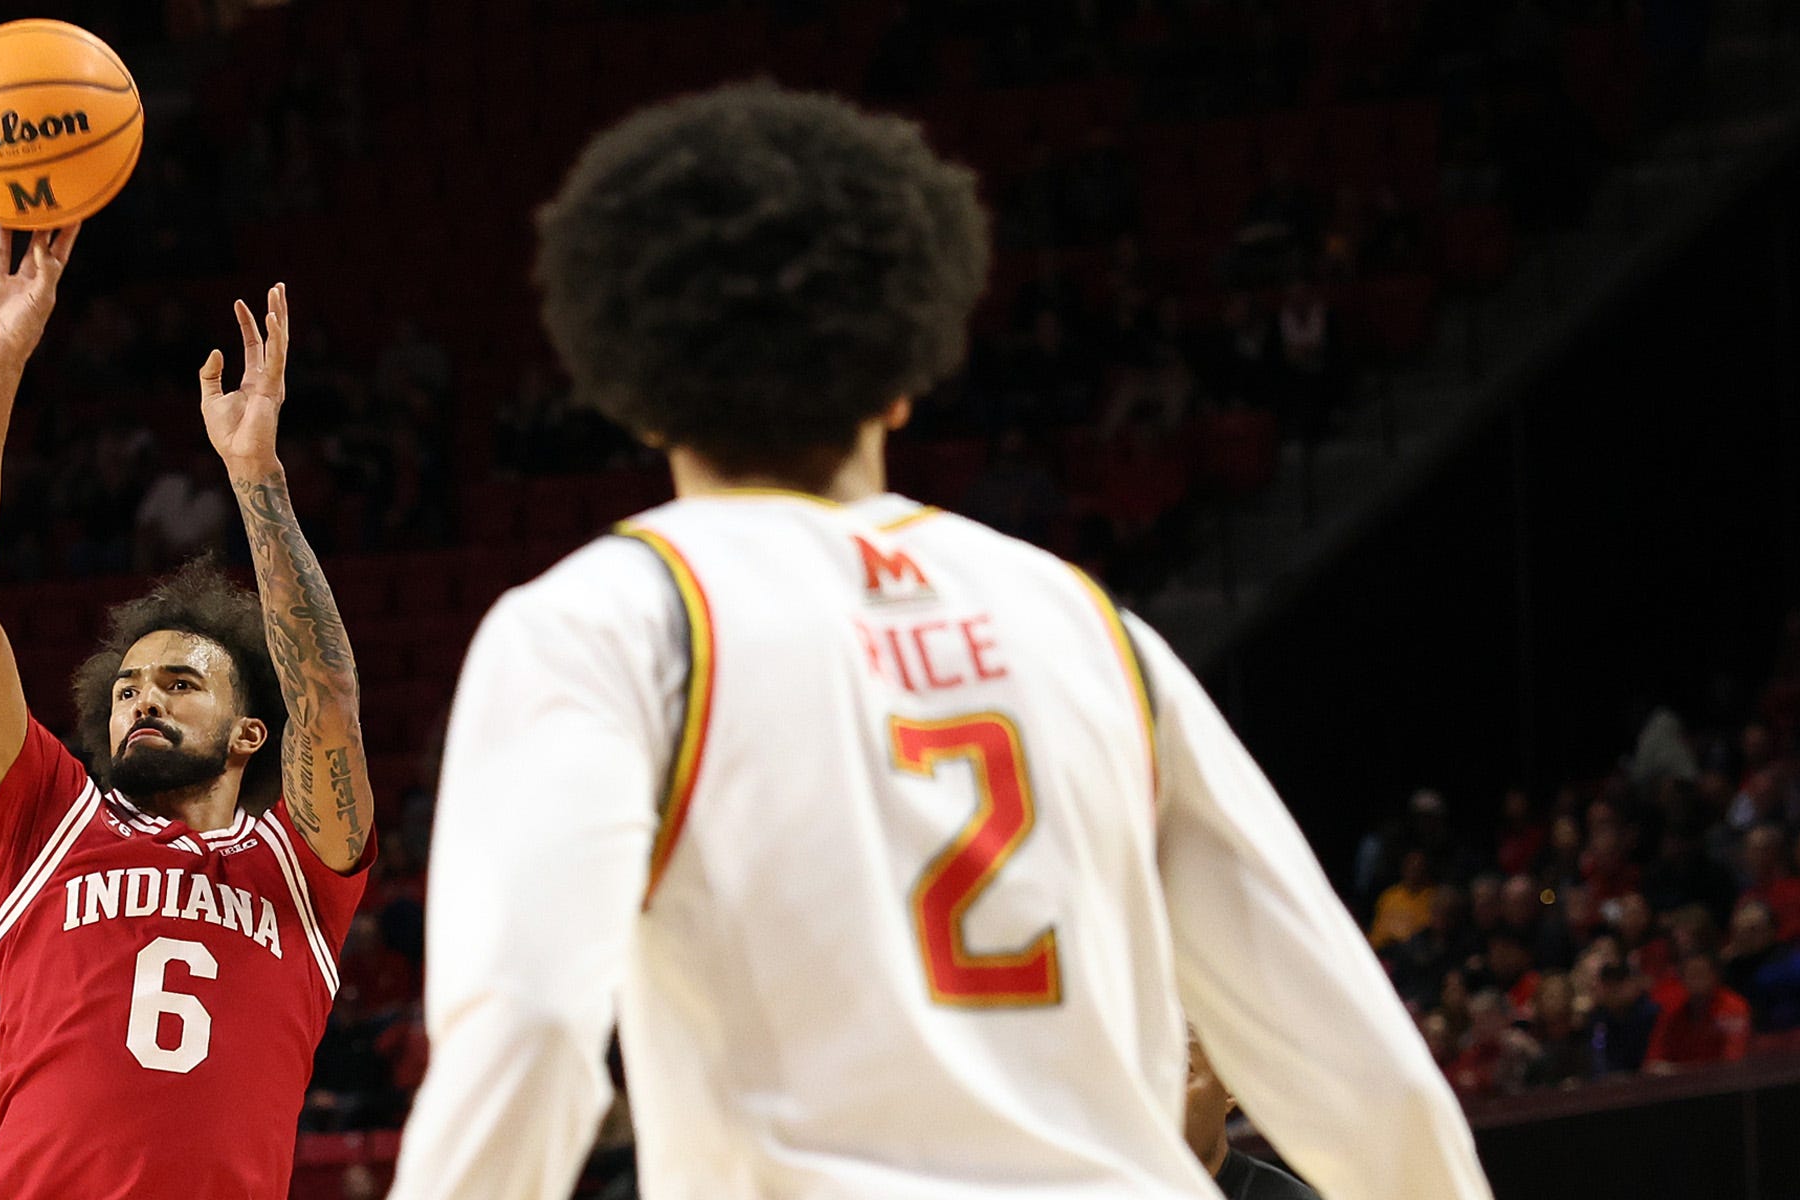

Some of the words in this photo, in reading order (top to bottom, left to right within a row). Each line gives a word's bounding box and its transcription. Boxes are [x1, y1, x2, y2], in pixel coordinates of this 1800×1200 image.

[6, 175, 62, 215] M
[63, 867, 283, 960] INDIANA
[889, 713, 1064, 1006] 2
[125, 936, 219, 1074] 6
